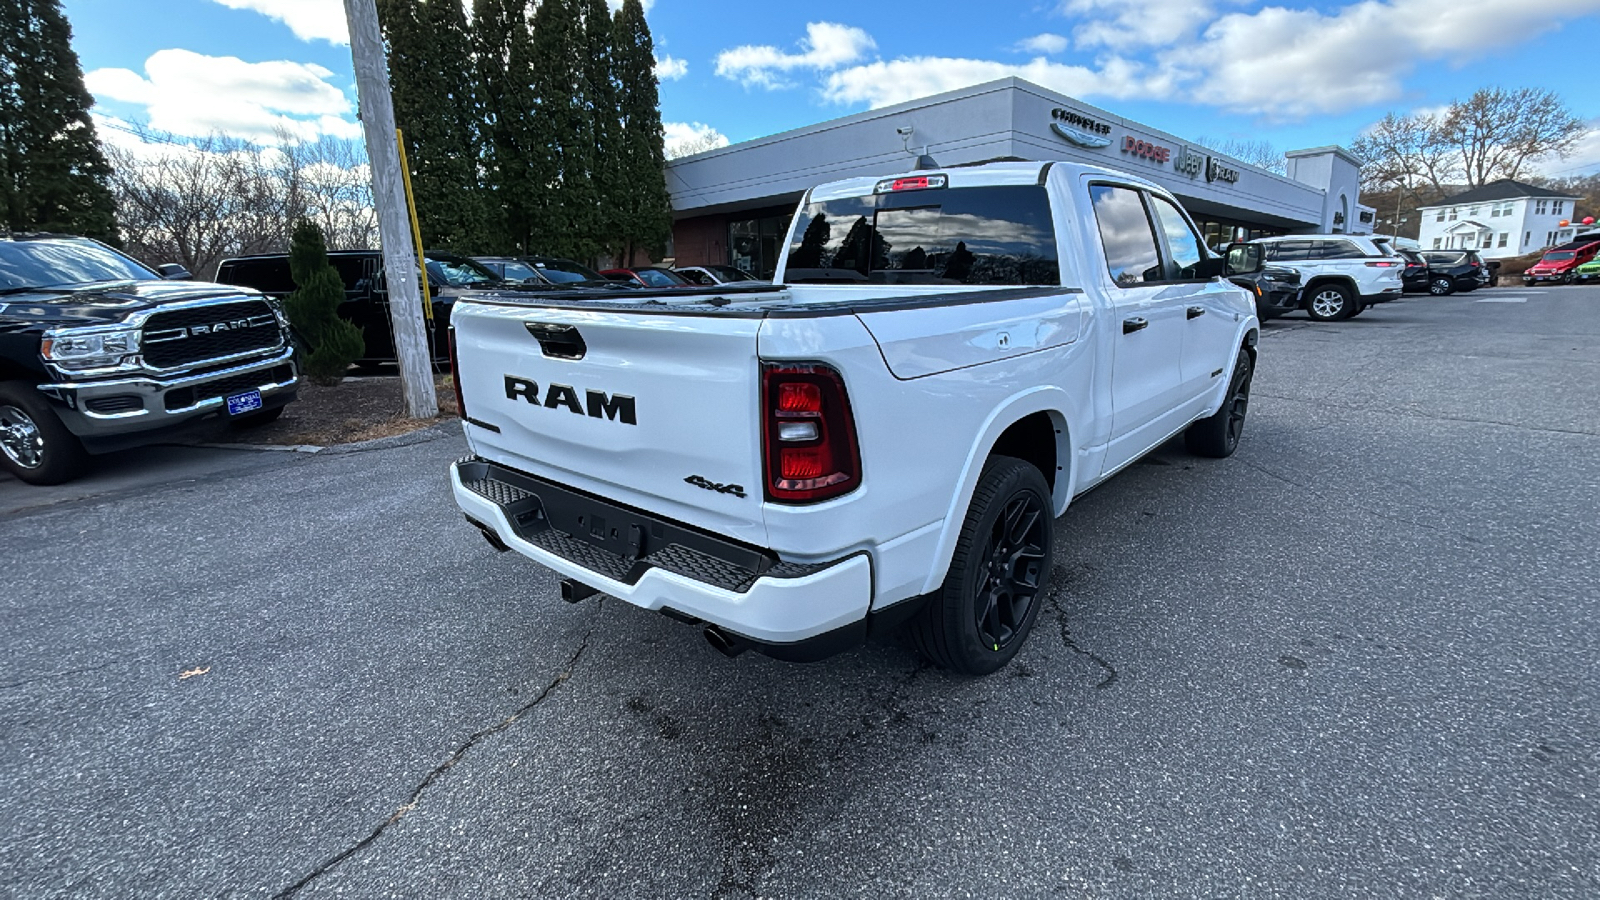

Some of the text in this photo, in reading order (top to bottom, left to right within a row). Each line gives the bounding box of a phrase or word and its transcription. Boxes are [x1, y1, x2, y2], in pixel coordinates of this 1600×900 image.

[1121, 136, 1170, 163] DODGE
[1174, 145, 1203, 180] Jeep
[1218, 165, 1239, 183] RAM
[191, 319, 248, 336] RAM
[504, 373, 637, 425] RAM
